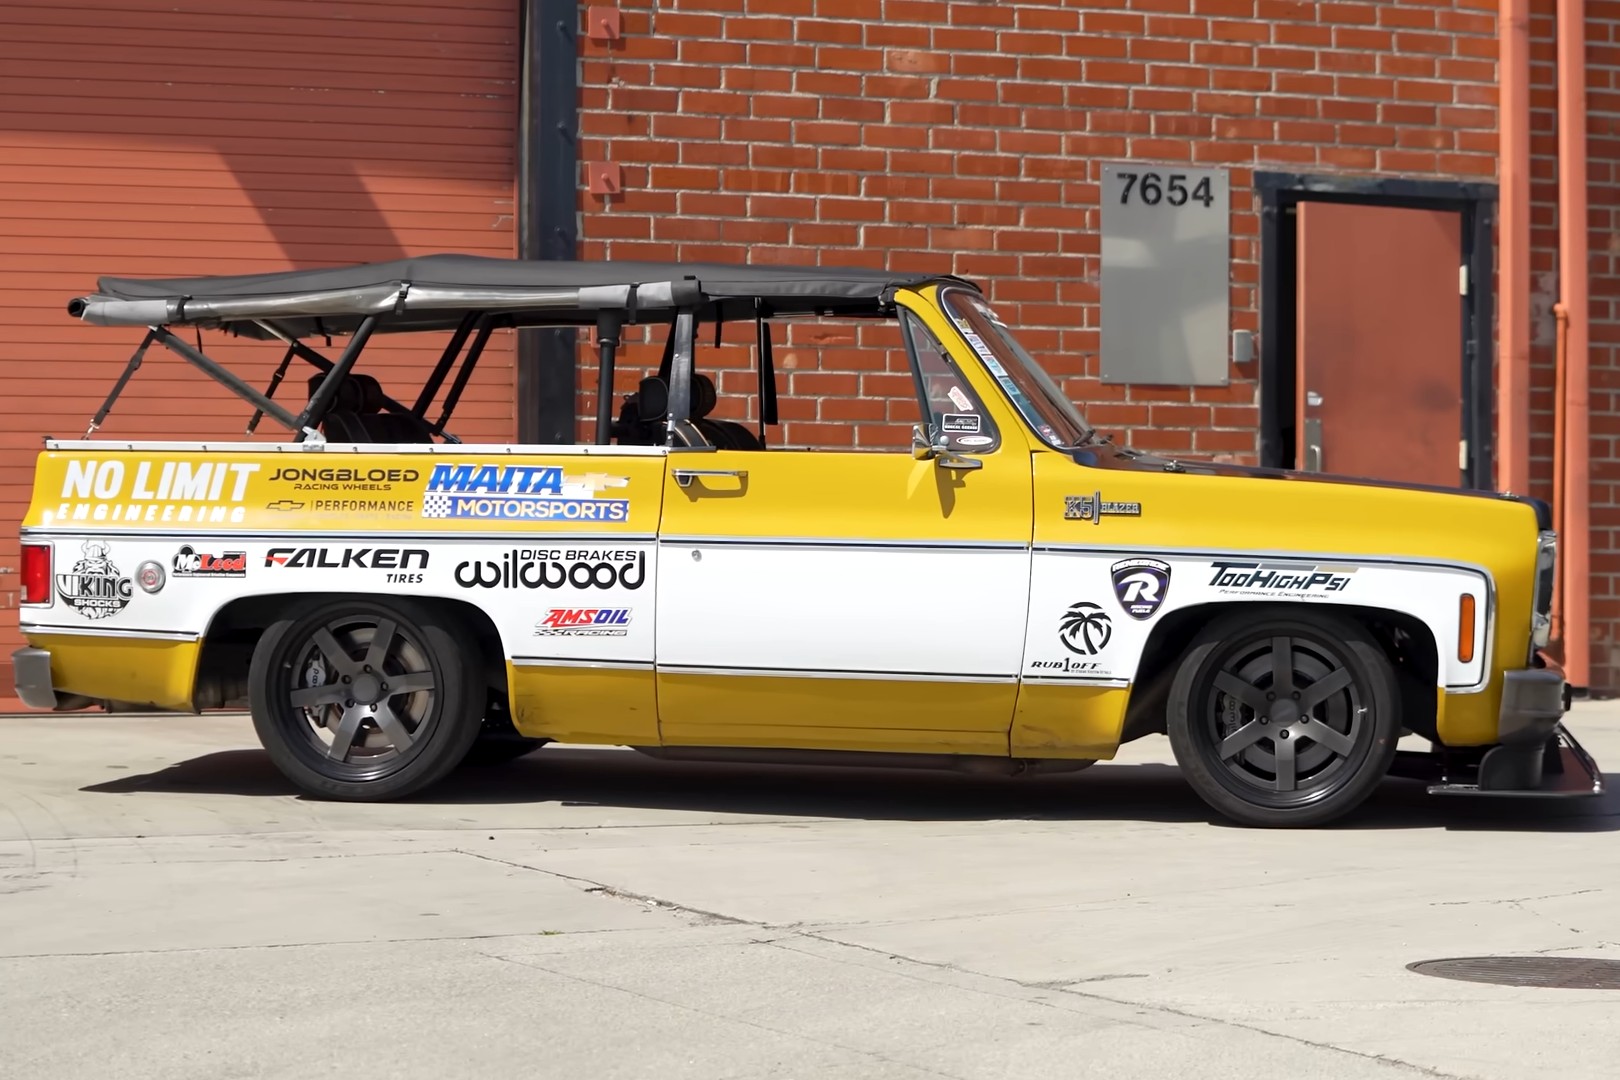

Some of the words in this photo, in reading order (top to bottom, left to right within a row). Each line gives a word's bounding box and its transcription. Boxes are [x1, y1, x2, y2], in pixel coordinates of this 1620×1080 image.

[1116, 172, 1214, 208] 7654
[61, 460, 125, 500] NO
[131, 461, 261, 502] LIMIT
[268, 468, 420, 482] JONGBLOED
[427, 464, 564, 495] MAITA
[293, 483, 339, 491] RACING
[342, 483, 392, 491] WHEELS
[56, 503, 247, 523] ENGINEERING
[315, 500, 414, 512] PERFORMANCE
[456, 499, 624, 520] MOTORSPORTS
[1064, 495, 1094, 520] K5
[1099, 502, 1141, 514] BLAZER
[262, 547, 430, 569] FALKEN
[520, 549, 561, 561] DISC
[565, 550, 637, 561] BRAKES
[386, 573, 423, 584] TIRES
[454, 549, 646, 590] wilwood
[55, 573, 134, 600] VIKING
[1117, 572, 1160, 602] R
[73, 598, 121, 607] SHOCKS
[541, 609, 629, 628] AMSOIL
[562, 629, 627, 637] RACING
